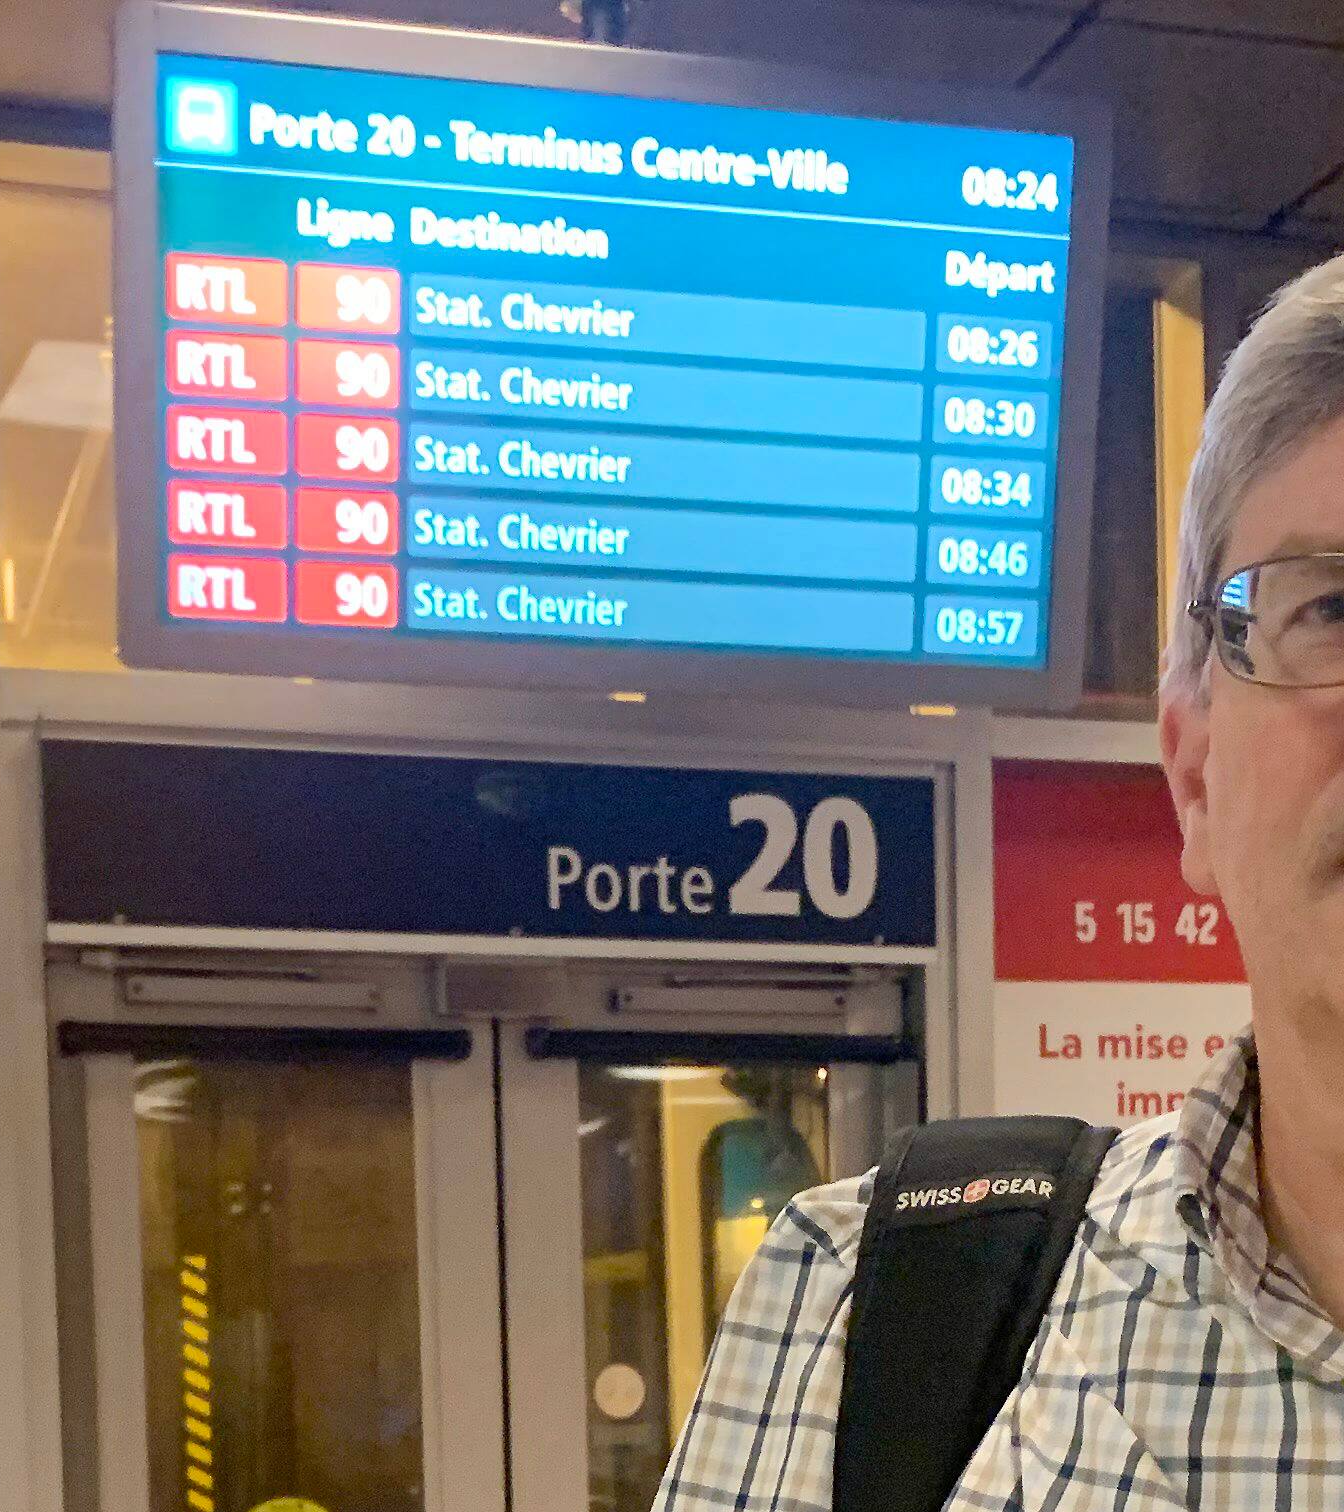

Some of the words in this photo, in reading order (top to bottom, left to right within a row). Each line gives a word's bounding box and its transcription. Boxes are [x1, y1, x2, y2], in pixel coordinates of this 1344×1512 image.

[249, 101, 359, 153] Porte
[367, 113, 416, 158] 20
[424, 133, 442, 149] -
[449, 120, 624, 176] Terminus
[631, 137, 850, 194] Centre-Ville
[962, 166, 1060, 212] 08:24
[297, 197, 395, 248] Ligne
[410, 207, 610, 259] Destination
[945, 250, 1056, 297] Départ
[176, 263, 257, 315] RTL
[336, 275, 391, 323] 90
[416, 286, 493, 329] Stat.
[501, 293, 635, 337] Chevrier
[947, 325, 1039, 367] 08:26
[176, 340, 257, 389] RTL
[335, 350, 391, 399] 90
[415, 361, 491, 402] Stat.
[500, 367, 634, 410] Chevrier
[944, 397, 1036, 437] 08:30
[176, 415, 257, 464] RTL
[336, 425, 389, 472] 90
[415, 436, 490, 475] Stat.
[498, 440, 632, 482] Chevrier
[941, 467, 1032, 507] 08:34
[177, 490, 256, 537] RTL
[335, 500, 389, 545] 90
[414, 508, 489, 547] Stat.
[497, 513, 630, 555] Chevrier
[938, 537, 1029, 577] 08:46
[177, 564, 256, 611] RTL
[335, 573, 388, 618] 90
[414, 583, 488, 620] Stat.
[496, 587, 628, 627] Chevrier
[936, 608, 1024, 645] 08:57
[548, 845, 715, 914] Porte
[728, 793, 878, 919] 20
[1075, 902, 1097, 943] 5
[1116, 902, 1155, 944] 15
[1174, 903, 1218, 945] 42
[1039, 1023, 1082, 1060] La
[1097, 1023, 1189, 1060] mise
[896, 1187, 962, 1211] SWISS
[991, 1178, 1053, 1199] GEAR
